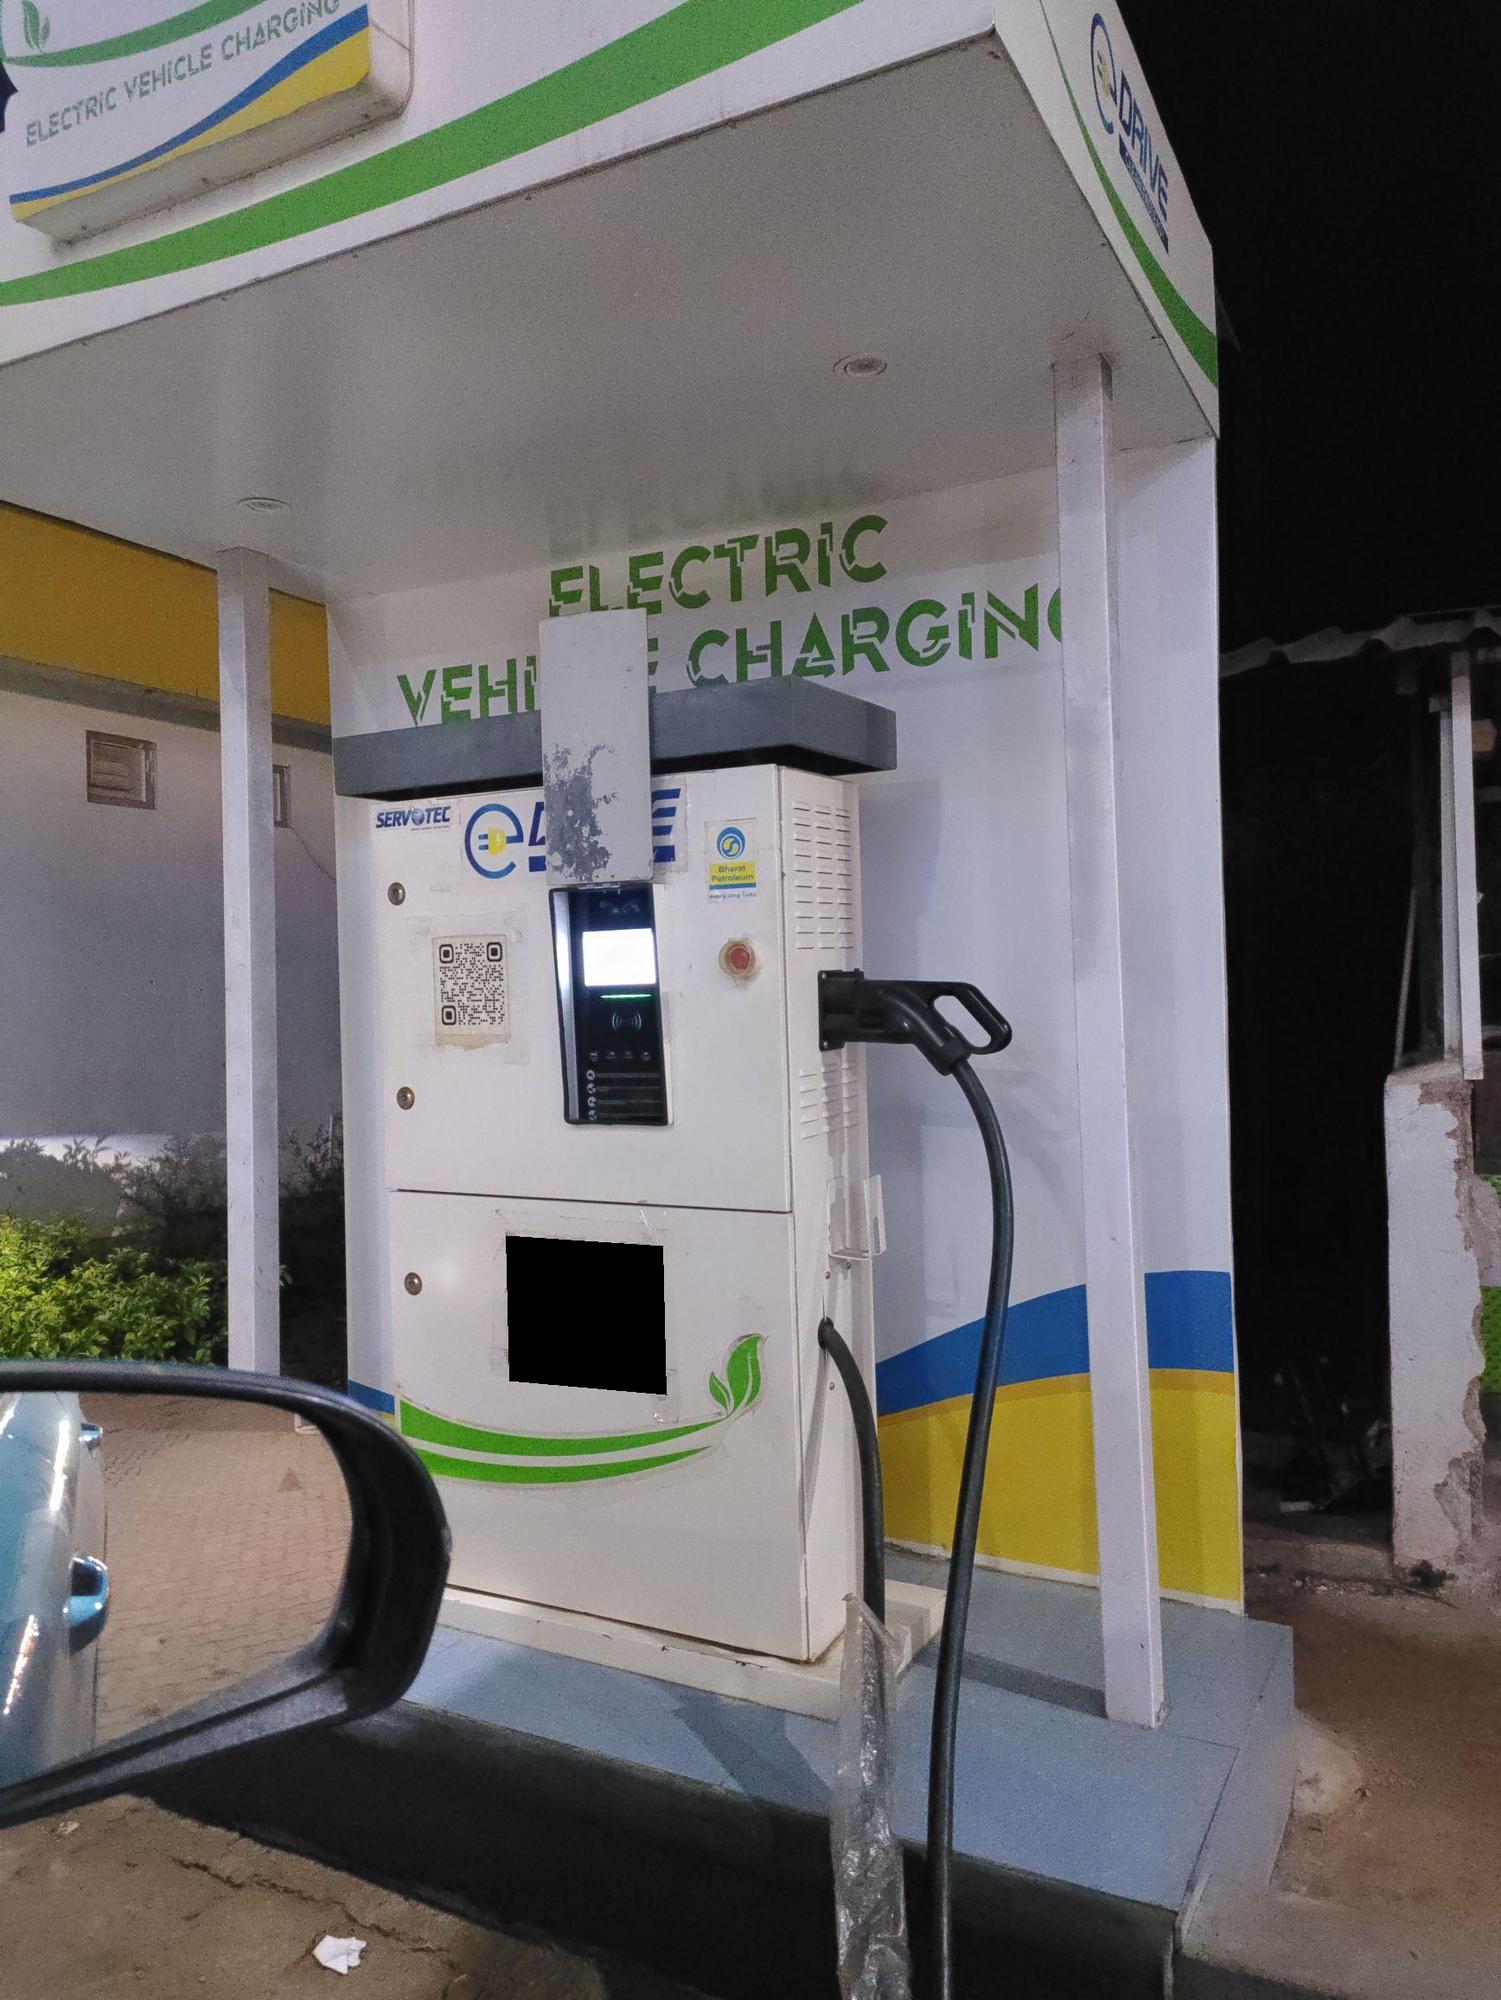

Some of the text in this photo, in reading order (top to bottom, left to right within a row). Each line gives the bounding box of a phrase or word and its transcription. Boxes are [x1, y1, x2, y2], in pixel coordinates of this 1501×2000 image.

[26, 87, 118, 147] ELECTRIC
[123, 43, 213, 100] VEHICLE
[549, 514, 888, 618] ELECTRIC
[397, 583, 1062, 728] VEHI CHARGIN
[375, 805, 451, 829] SERVOTEC
